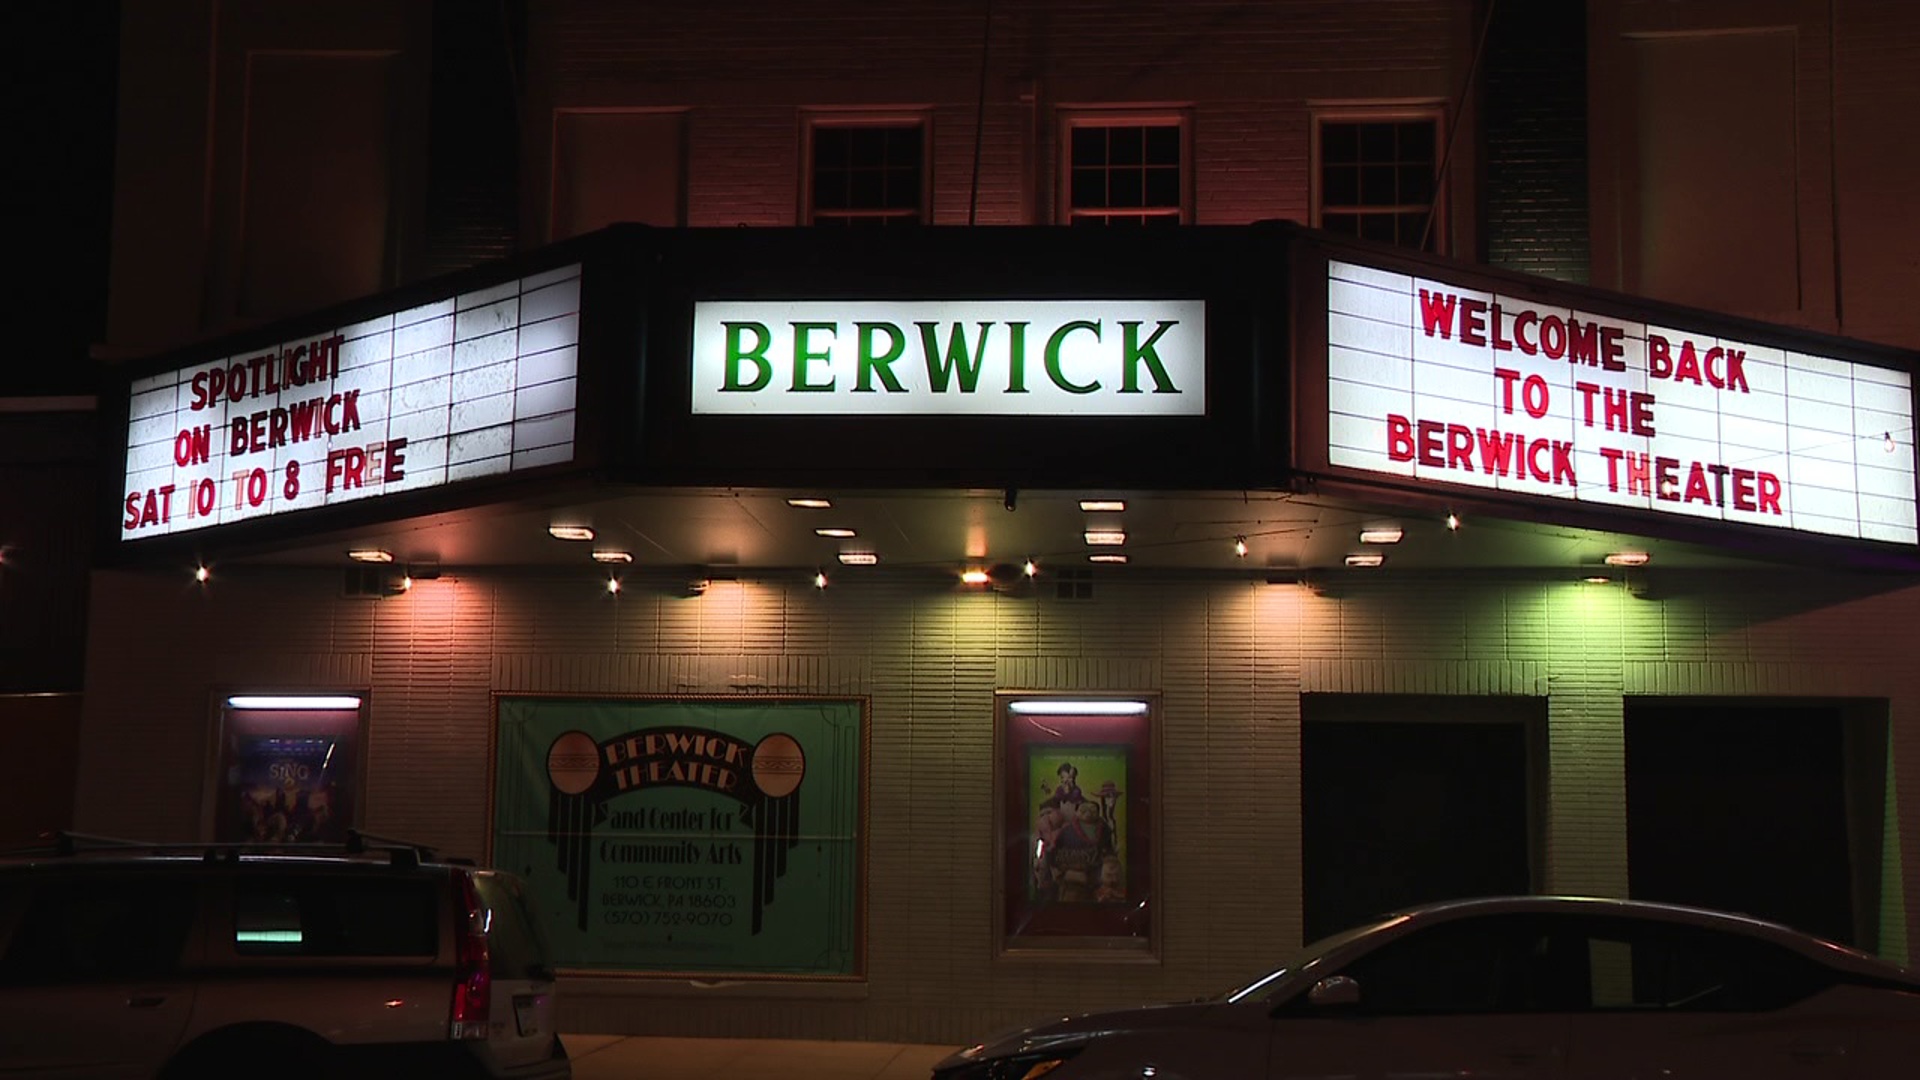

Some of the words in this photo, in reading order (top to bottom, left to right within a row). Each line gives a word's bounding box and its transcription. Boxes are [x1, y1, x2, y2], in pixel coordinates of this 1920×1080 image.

[717, 318, 1183, 394] BERWICK
[1419, 288, 1626, 372] WELCOME
[1647, 334, 1750, 393] BACK
[190, 334, 344, 411] SPOTLIGHT
[174, 423, 210, 467] ON
[230, 389, 361, 456] BERWICK
[1494, 368, 1549, 419] TO
[1576, 381, 1655, 437] THE
[124, 484, 175, 530] SAT
[188, 477, 215, 519] 10
[232, 468, 267, 510] TO
[283, 460, 300, 500] 8
[326, 438, 407, 494] FREE
[1387, 413, 1577, 486] BERWICK
[1600, 447, 1782, 515] THEATER
[605, 732, 745, 768] BERWICK
[614, 760, 738, 792] THEATER
[611, 807, 645, 829] and
[650, 806, 707, 830] Center
[710, 806, 733, 829] for
[600, 839, 701, 866] Community
[706, 840, 743, 864] Arts
[613, 875, 639, 889] 110
[643, 876, 654, 889] E
[657, 875, 702, 890] FRONT
[668, 894, 684, 909] PA
[688, 893, 736, 909] 18603
[604, 911, 650, 925] (570)
[653, 911, 734, 927] 752-9070
